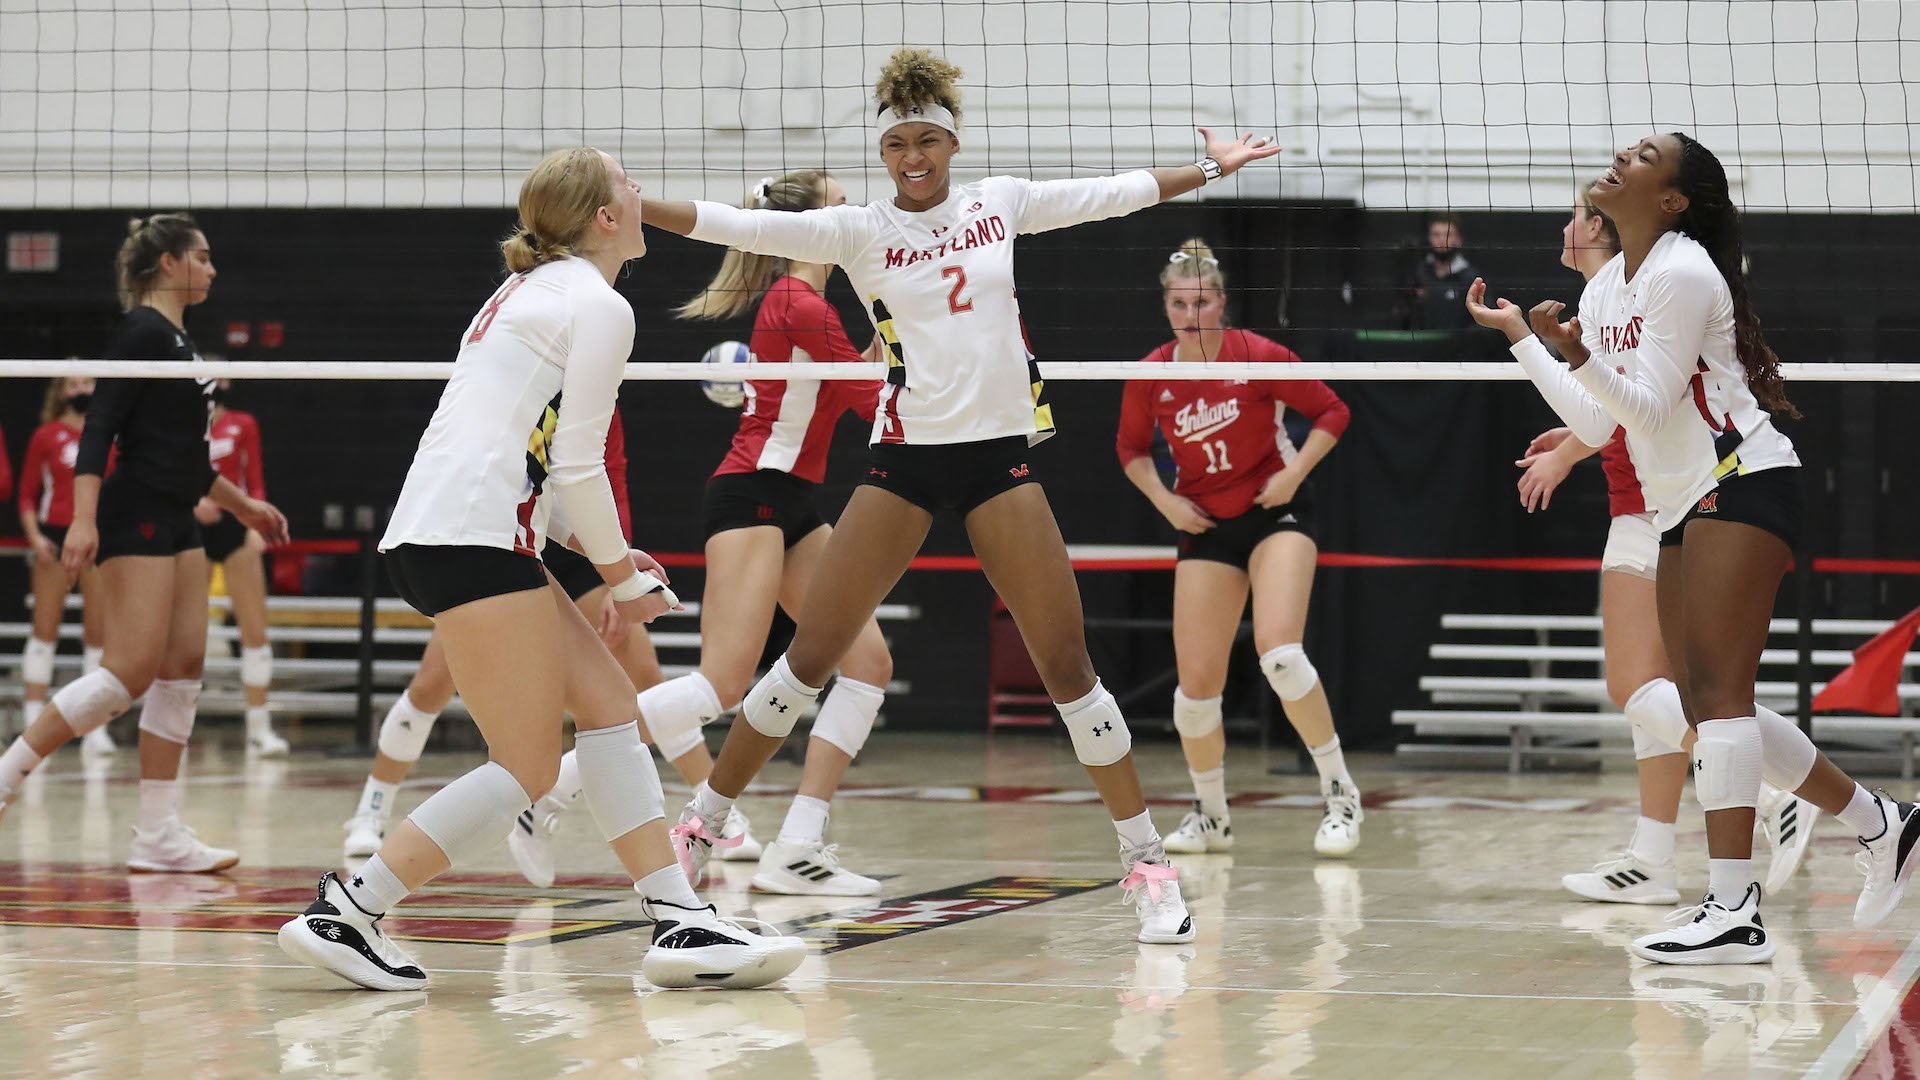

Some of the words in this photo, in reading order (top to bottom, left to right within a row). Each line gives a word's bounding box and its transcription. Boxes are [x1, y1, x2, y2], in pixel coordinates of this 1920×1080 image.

[885, 215, 1005, 269] MARYLAND
[467, 277, 526, 344] 8
[941, 265, 974, 315] 2
[1173, 397, 1240, 440] Indiana
[1202, 440, 1233, 474] 11
[1697, 492, 1719, 513] M
